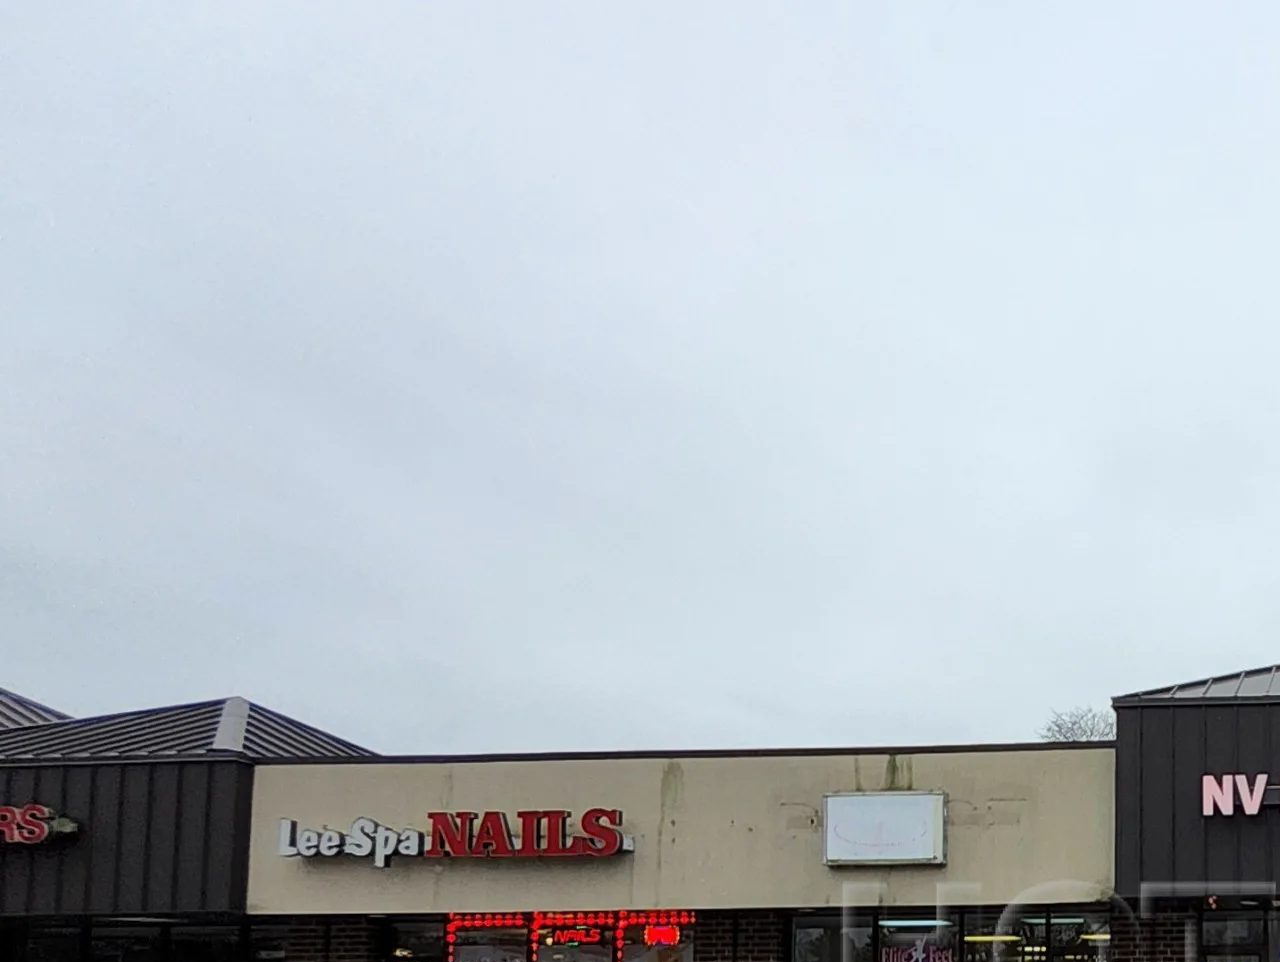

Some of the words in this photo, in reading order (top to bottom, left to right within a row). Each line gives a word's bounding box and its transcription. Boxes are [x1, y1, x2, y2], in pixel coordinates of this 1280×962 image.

[1202, 774, 1268, 815] NV
[279, 817, 343, 857] Lee
[345, 816, 423, 867] Spa
[424, 808, 624, 858] NAILS
